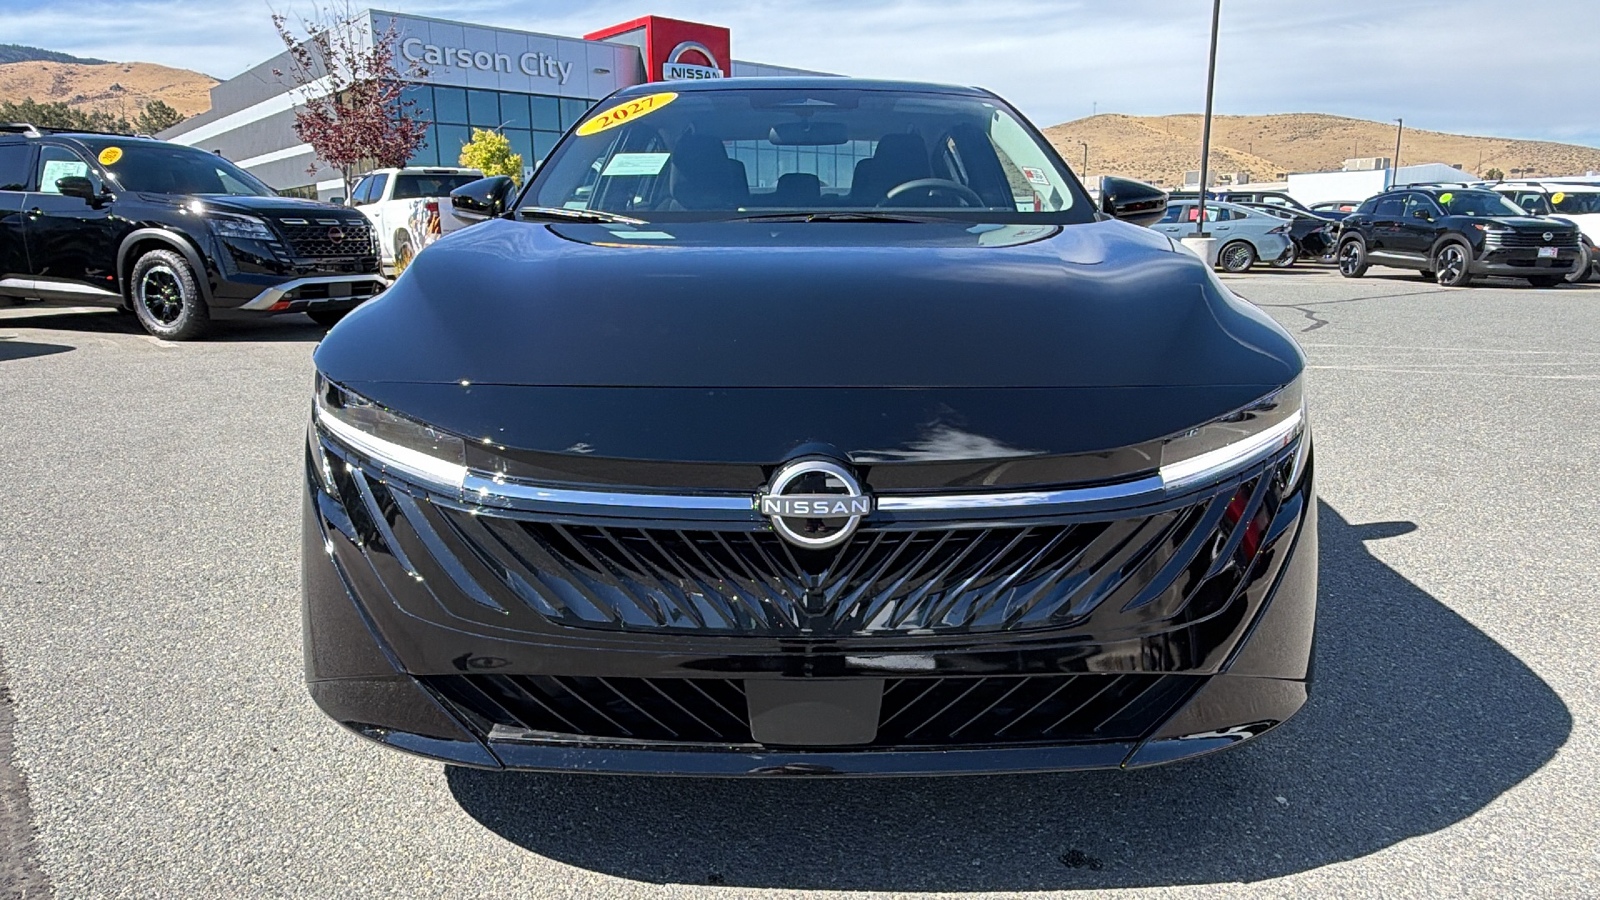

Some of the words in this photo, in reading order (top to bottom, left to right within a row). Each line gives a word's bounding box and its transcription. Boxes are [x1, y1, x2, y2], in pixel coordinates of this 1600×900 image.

[402, 38, 512, 73] Carson
[520, 51, 573, 85] City
[671, 67, 720, 79] NISSAN
[597, 97, 654, 128] 2027
[764, 499, 867, 514] NISSAN
